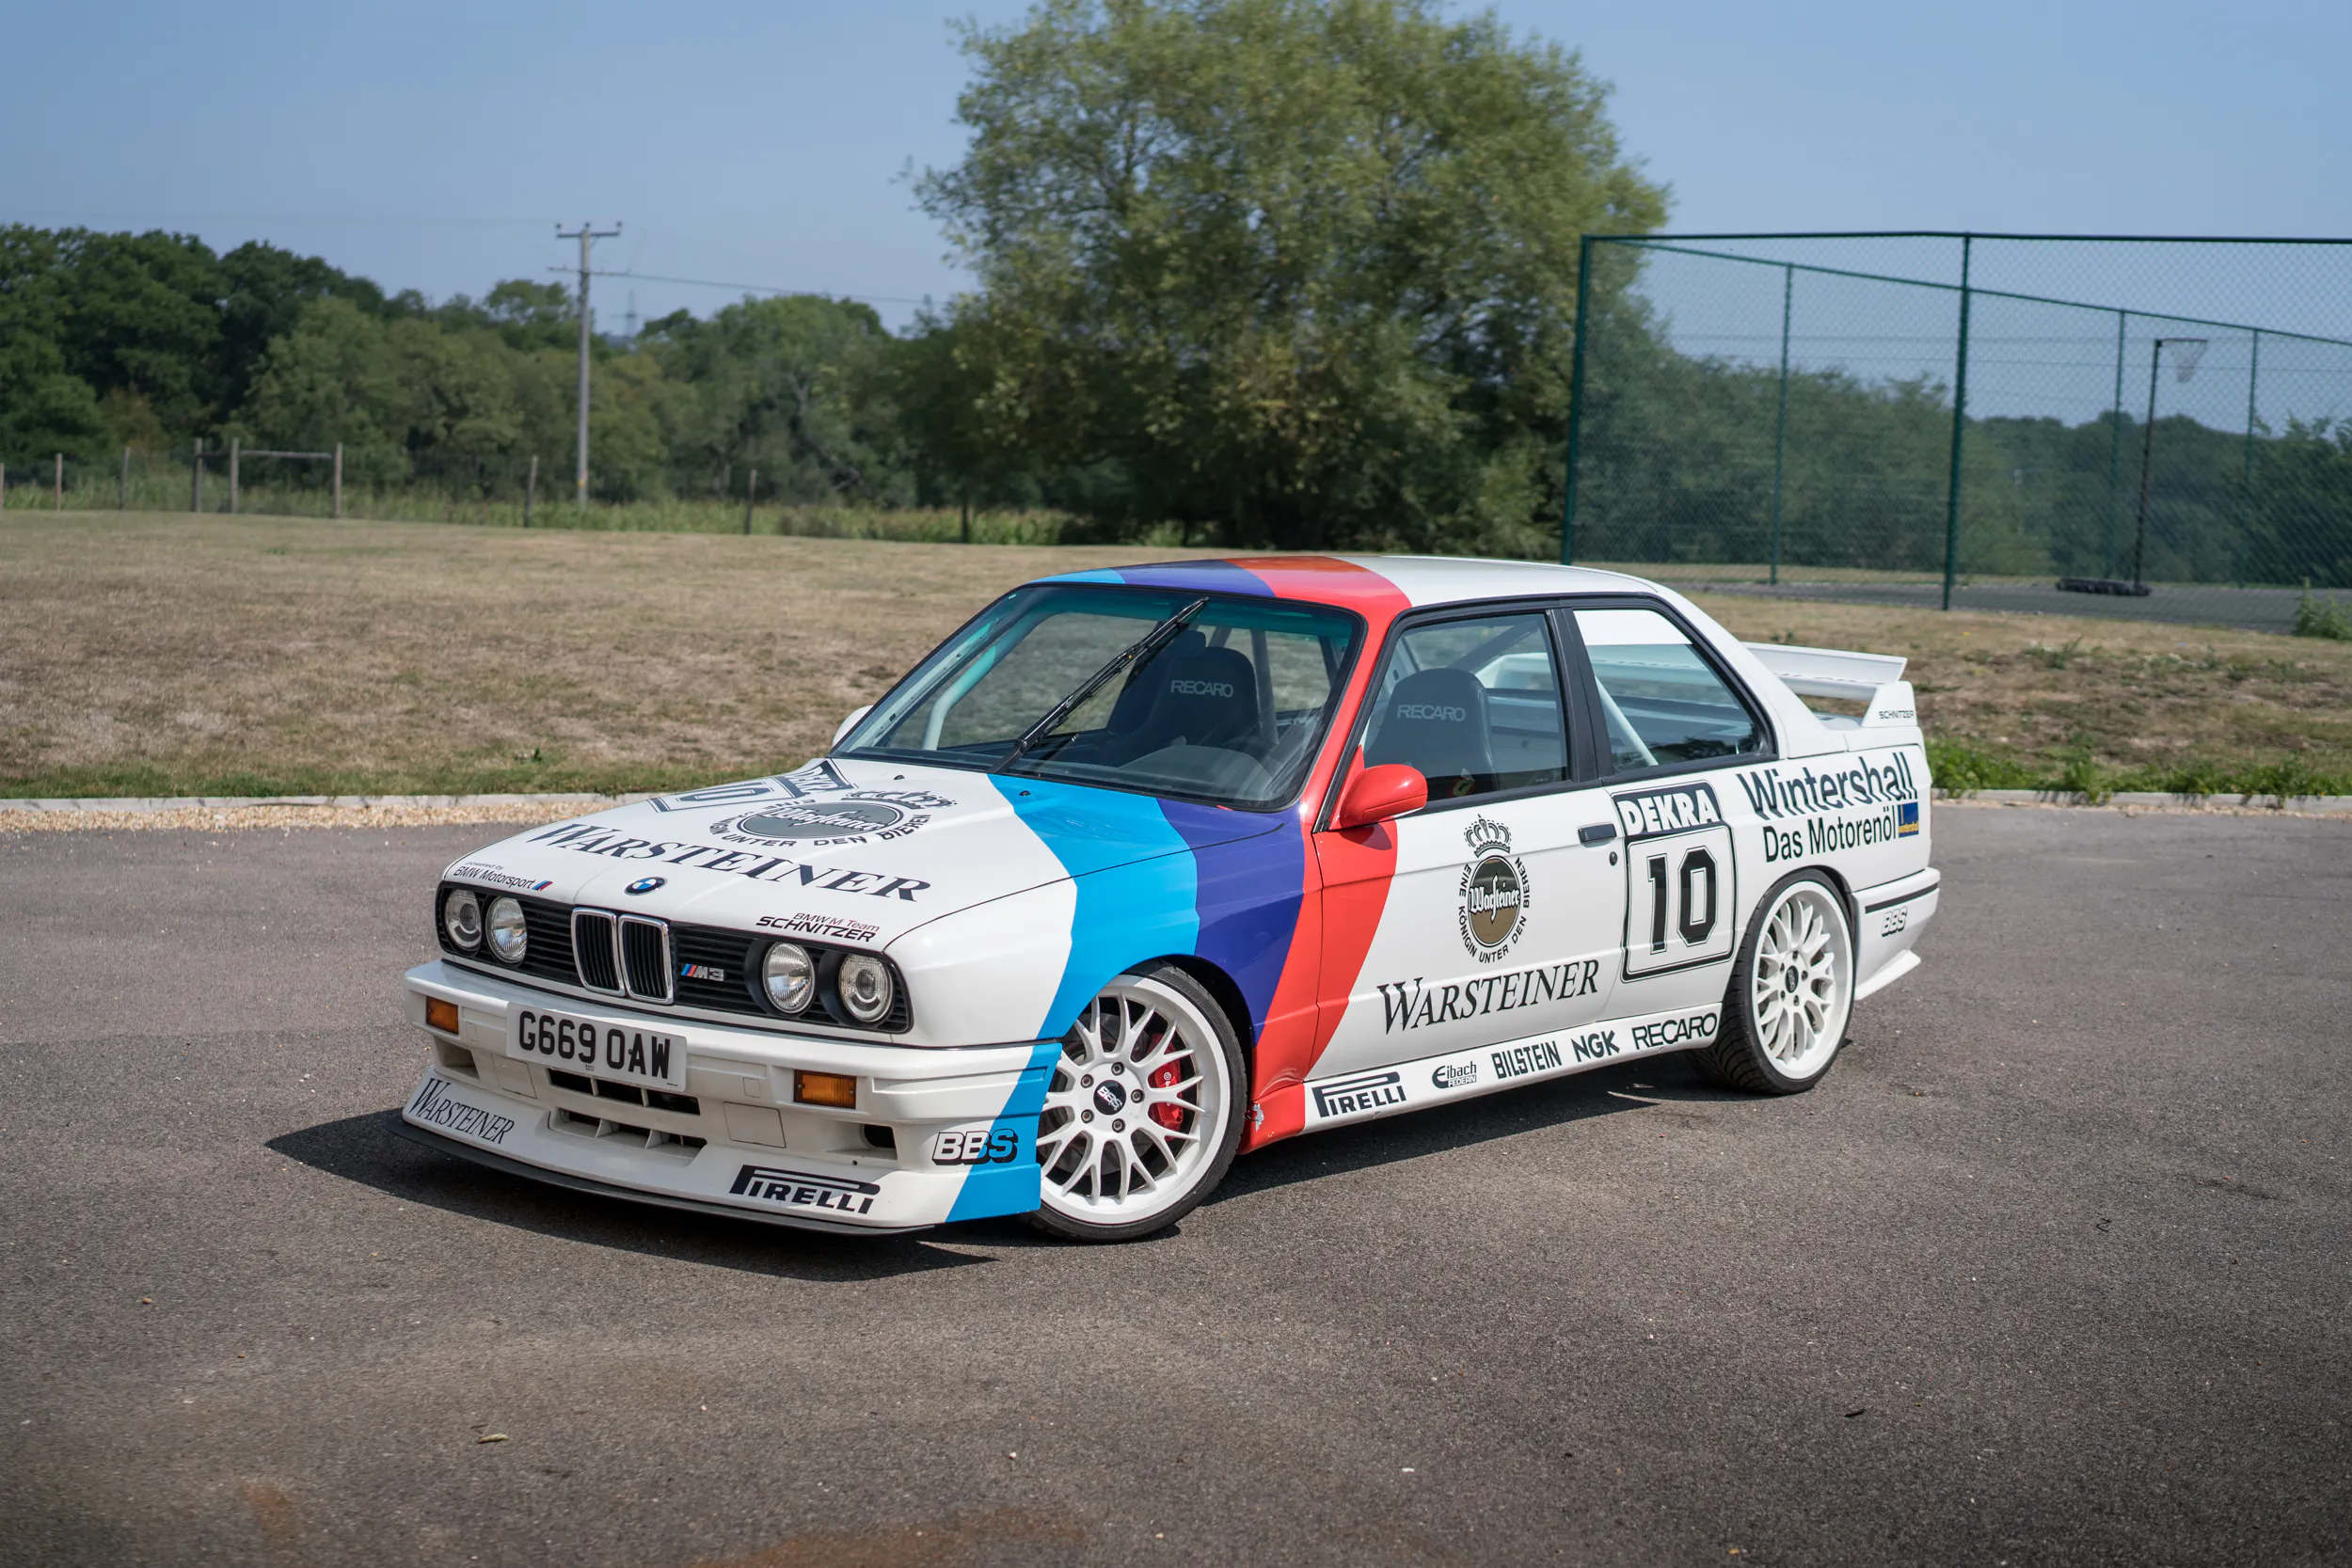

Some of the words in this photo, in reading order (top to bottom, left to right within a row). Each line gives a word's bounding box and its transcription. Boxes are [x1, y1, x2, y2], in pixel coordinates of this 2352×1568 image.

[1170, 680, 1233, 698] RECARO
[1397, 705, 1466, 722] RECARO
[1879, 710, 1915, 720] SCHNITZER
[1736, 752, 1917, 820] Wintershall
[1616, 789, 1721, 837] DEKRA
[722, 833, 797, 847] UNTER
[814, 836, 867, 847] DEN
[876, 814, 931, 840] BIEREN
[1762, 825, 1804, 863] Das
[1807, 805, 1897, 855] Motorenöl
[453, 866, 481, 879] BMW
[480, 869, 535, 889] Motorsport
[525, 823, 930, 902] WARSTEINER
[1459, 863, 1472, 897] EINE
[1515, 857, 1531, 908] BIEREN
[1646, 846, 1719, 955] 10
[755, 916, 876, 942] SCHNITZER
[794, 912, 830, 925] BMW
[830, 917, 844, 927] M
[847, 919, 880, 932] Team
[1458, 906, 1478, 958] KÖNIGIN
[1512, 916, 1527, 943] DEN
[1882, 906, 1908, 937] BBS
[1479, 944, 1509, 963] UNTER
[691, 964, 725, 982] M3
[1376, 959, 1599, 1035] WARSTEINER
[519, 1010, 596, 1064] G669
[607, 1029, 671, 1079] OAW
[1571, 1030, 1620, 1063] NGK
[1631, 1012, 1718, 1050] RECARO
[1432, 1060, 1477, 1088] Eibach
[1491, 1040, 1562, 1080] BILSTEIN
[1097, 1085, 1123, 1110] BBS
[1311, 1070, 1406, 1117] PIRELLI
[1447, 1074, 1477, 1087] FEDERN
[408, 1077, 515, 1144] WARSTEINER
[931, 1129, 1019, 1165] BBS
[729, 1164, 881, 1214] PIRELLI
